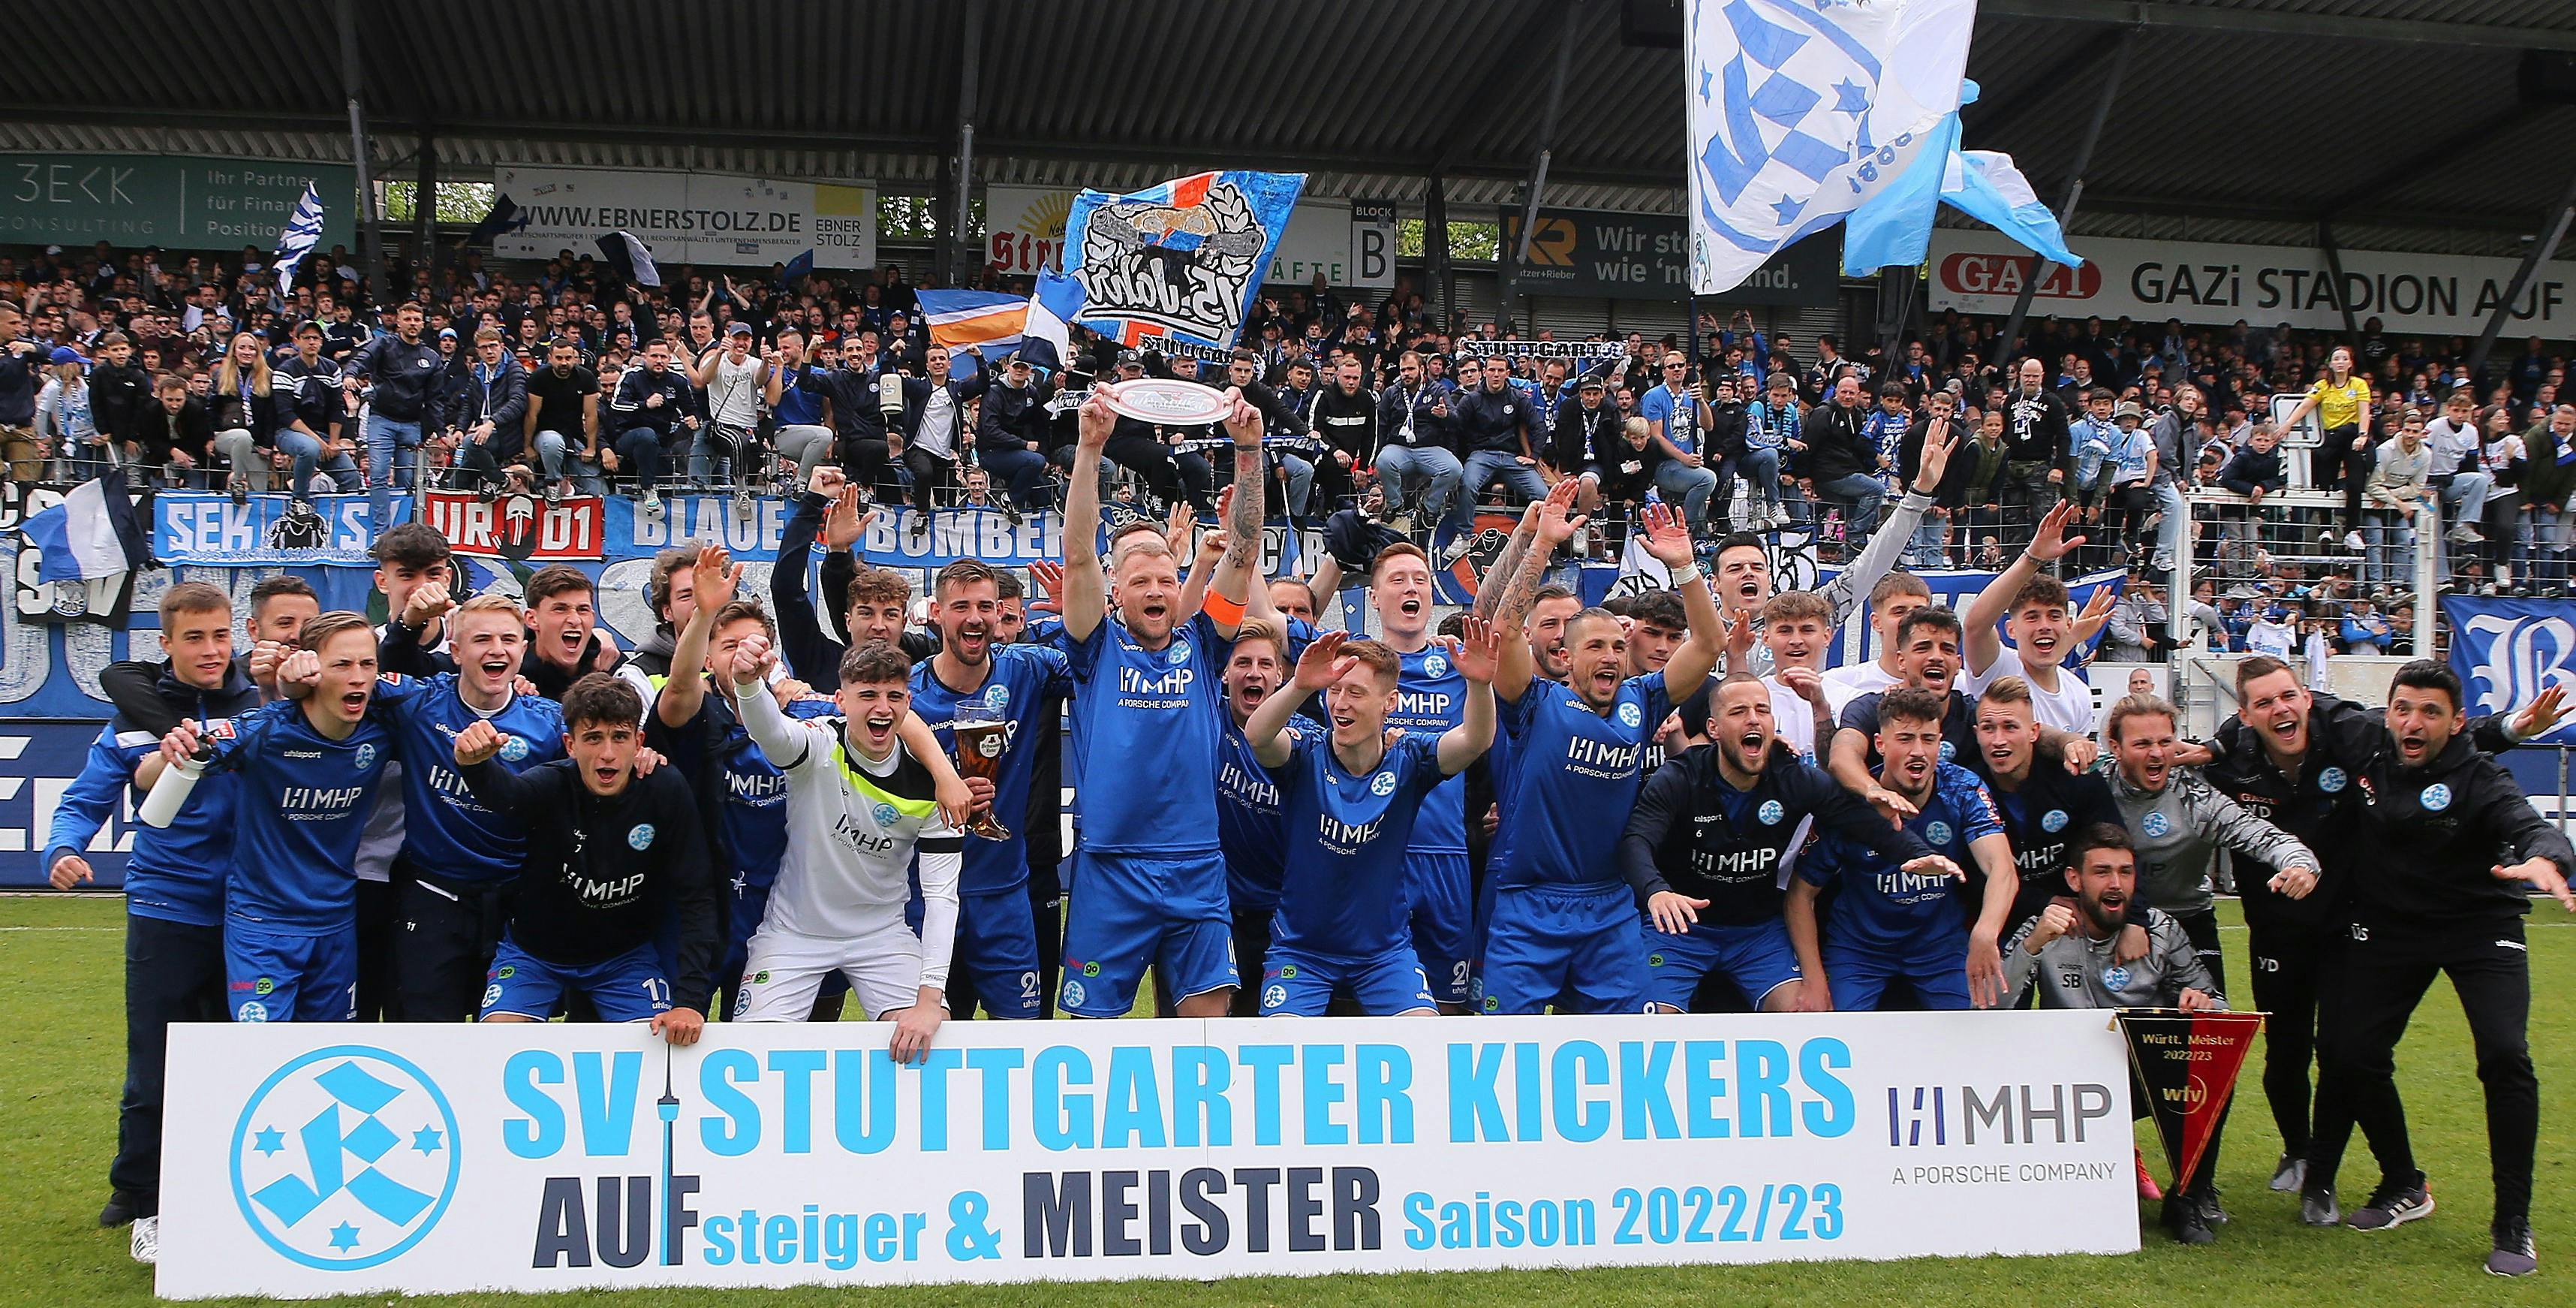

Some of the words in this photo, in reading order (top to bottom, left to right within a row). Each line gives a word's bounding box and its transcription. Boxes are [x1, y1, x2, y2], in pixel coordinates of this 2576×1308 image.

[207, 170, 236, 185] Ihr
[207, 195, 236, 210] für
[1356, 206, 1392, 217] BLOCK
[816, 219, 862, 233] EBNER
[715, 237, 802, 246] UNTERNEHMENSBERATER
[816, 234, 861, 247] STOLZ
[1595, 226, 1647, 252] Wir
[1362, 229, 1386, 279] B
[1594, 255, 1648, 282] wie
[1957, 256, 2085, 297] GAZI
[2131, 262, 2240, 307] GAZi
[2257, 267, 2458, 317] STADION
[2471, 278, 2563, 321] AUF
[1462, 341, 1602, 358] STUTTGART
[167, 502, 253, 550] SEK
[633, 498, 786, 552] BLAUE
[1141, 668, 1194, 695] MHP
[1124, 699, 1160, 709] PORSCHE
[1397, 692, 1450, 714] MHP
[1416, 719, 1449, 727] COMPANY
[284, 750, 322, 760] uhlsport
[1595, 742, 1642, 768] MHP
[1565, 764, 1572, 772] A
[1572, 765, 1610, 779] PORSCHE
[734, 773, 787, 796] MHP
[310, 787, 363, 809] MHP
[287, 812, 324, 821] PORSCHE
[1696, 829, 1702, 838] 6
[1323, 841, 1356, 855] PORSCHE
[1718, 848, 1777, 873] MHP
[582, 873, 645, 900] MHP
[500, 967, 513, 976] go
[1085, 964, 1098, 974] go
[2258, 956, 2280, 972] YD
[755, 972, 767, 981] go
[1282, 968, 1295, 977] go
[257, 981, 271, 991] go
[2062, 974, 2081, 988] SB
[1485, 999, 1497, 1009] go
[2141, 1033, 2182, 1045] Württ.
[2187, 1034, 2235, 1046] Meister
[2162, 1050, 2213, 1061] 2022/23
[502, 1048, 643, 1159] SV
[699, 1043, 1416, 1158] STUTTGARTER
[1446, 1036, 1857, 1143] KICKERS
[1961, 1083, 2114, 1145] MHP
[1892, 1167, 1906, 1185] A
[1913, 1165, 2011, 1184] PORSCHE
[2018, 1162, 2117, 1182] COMPANY
[944, 1190, 1002, 1263] &
[1022, 1166, 1382, 1258] MEISTER
[1402, 1190, 1596, 1251] Saison
[1612, 1183, 1844, 1246] 2022/23
